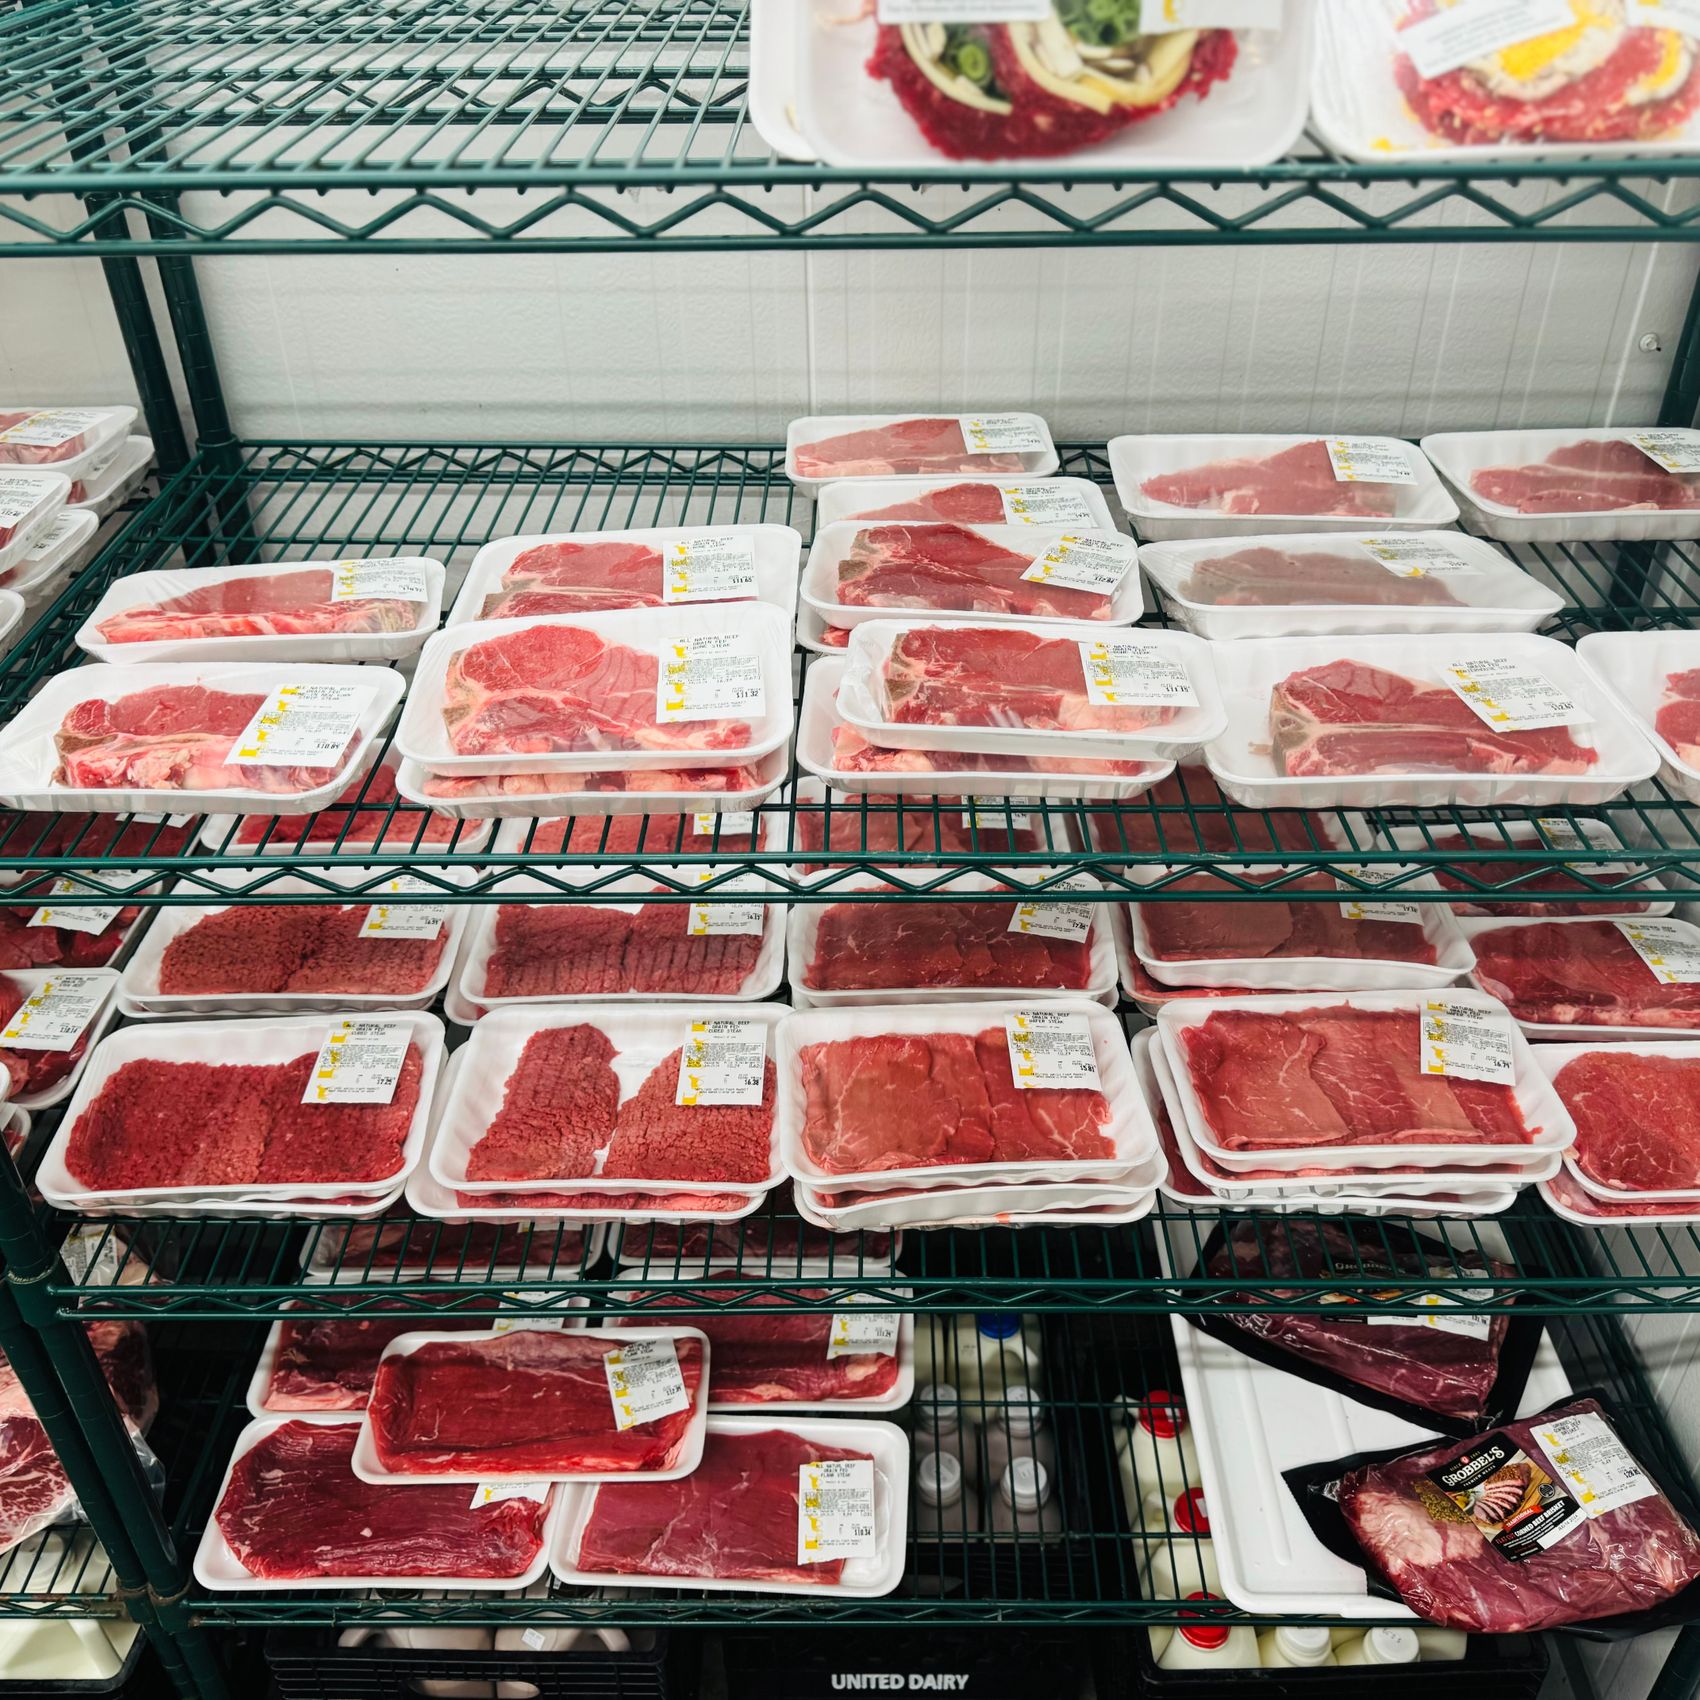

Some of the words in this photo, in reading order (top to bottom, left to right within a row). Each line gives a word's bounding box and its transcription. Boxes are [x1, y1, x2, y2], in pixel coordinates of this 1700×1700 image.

[1442, 1446, 1504, 1486] GROBBEL'S
[1532, 1514, 1546, 1527] BEEF
[832, 1674, 904, 1690] UNITED
[908, 1674, 970, 1690] DAIRY
